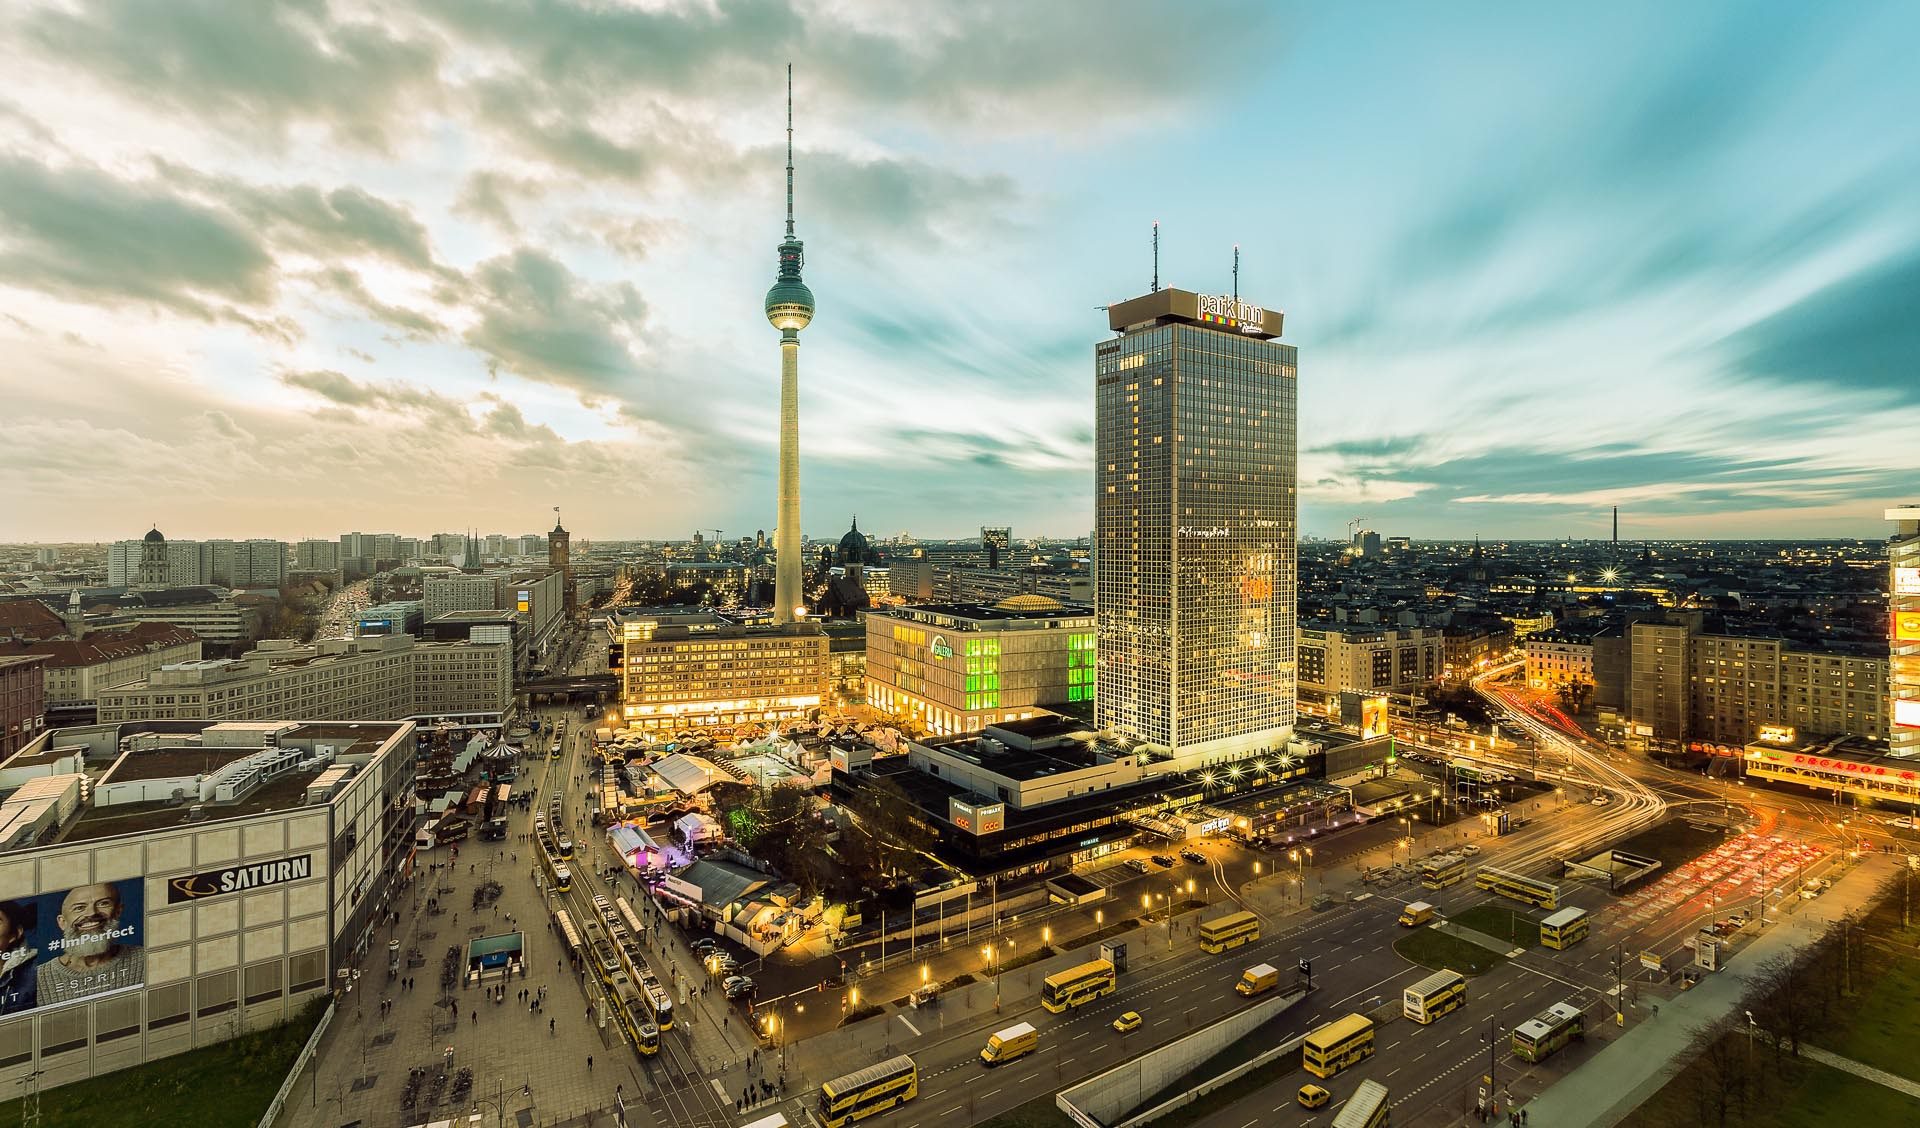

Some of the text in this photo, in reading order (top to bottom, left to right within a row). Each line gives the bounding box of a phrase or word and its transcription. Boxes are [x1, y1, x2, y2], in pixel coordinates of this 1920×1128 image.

[1197, 293, 1264, 324] park inn
[935, 644, 953, 658] GALERIA
[980, 807, 1002, 816] PRIMARK
[956, 816, 969, 829] CCC
[984, 821, 999, 831] CCC
[220, 857, 308, 892] SATURN
[48, 925, 135, 951] #ImPerfect
[55, 968, 128, 993] ESPRIT
